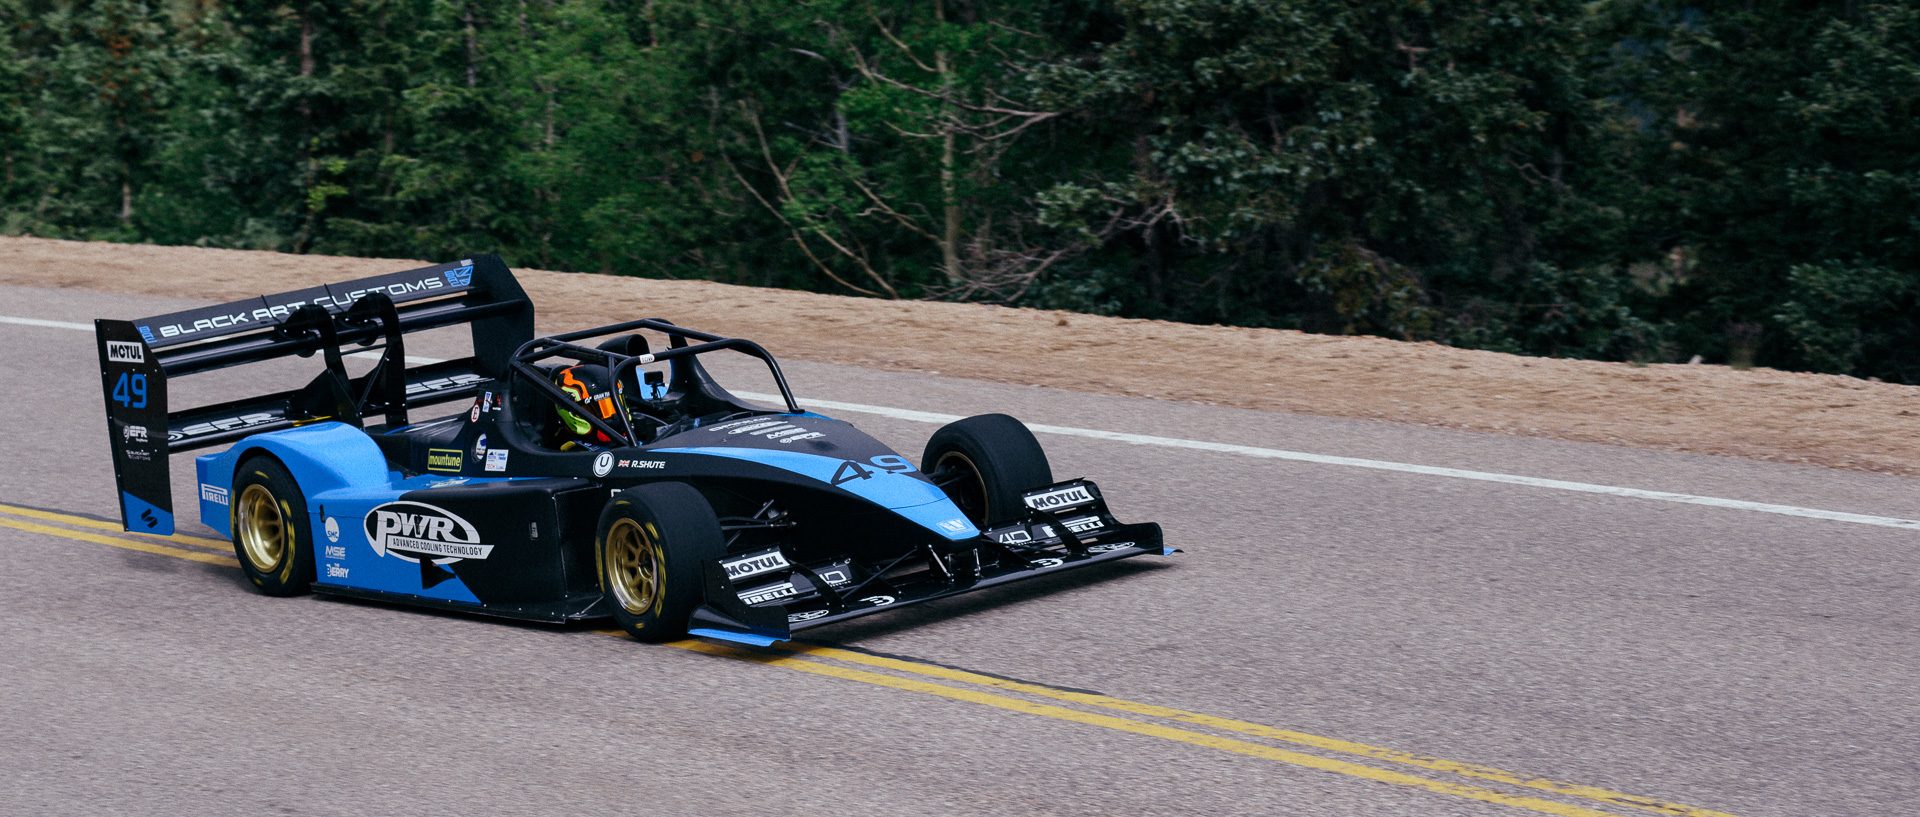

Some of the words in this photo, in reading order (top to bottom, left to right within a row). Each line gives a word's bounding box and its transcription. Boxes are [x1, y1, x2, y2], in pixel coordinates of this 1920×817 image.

[160, 312, 249, 338] BLACK
[109, 344, 142, 360] MOTUL
[113, 373, 147, 409] 49
[429, 454, 460, 467] mountune
[631, 461, 666, 469] R.SHUTE
[831, 455, 918, 486] 49
[201, 483, 228, 506] PIRELLI
[1031, 489, 1089, 508] MOTUL
[376, 510, 457, 554] PWR
[1042, 515, 1105, 538] PELLI
[326, 546, 346, 557] MSE
[392, 538, 420, 550] ADVANCED
[420, 542, 443, 553] COOLING
[443, 545, 482, 556] TECHNOLOGY
[726, 555, 784, 577] MOTUL
